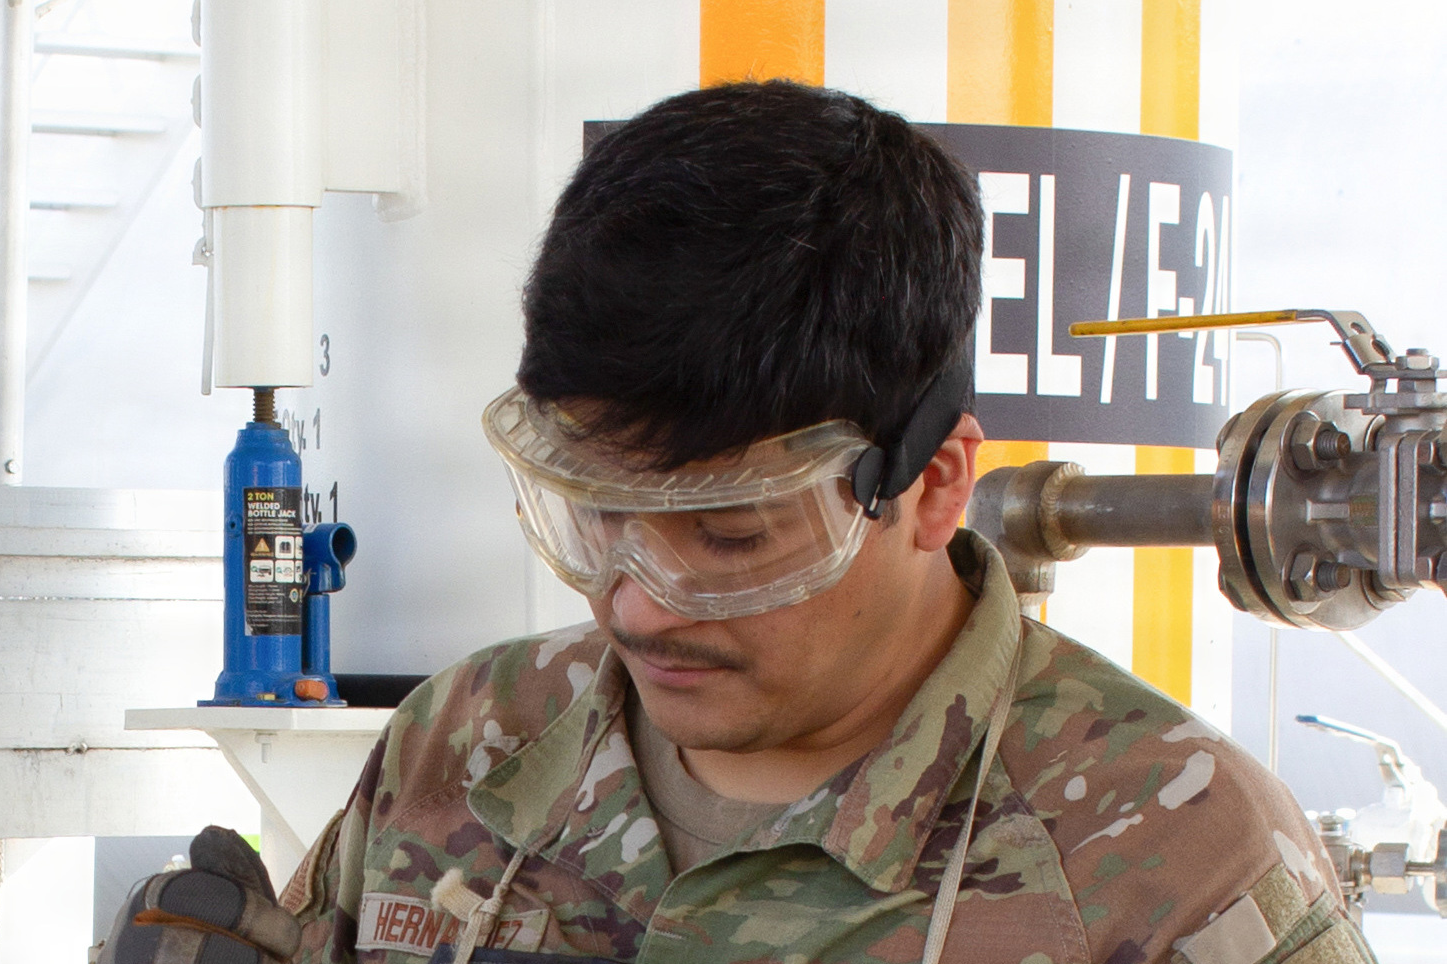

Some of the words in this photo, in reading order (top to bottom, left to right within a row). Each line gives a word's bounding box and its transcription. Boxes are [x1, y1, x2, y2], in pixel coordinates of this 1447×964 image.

[975, 171, 1082, 397] EL
[1099, 173, 1131, 404] /
[1145, 181, 1230, 406] F-24
[319, 334, 331, 377] 3
[313, 407, 321, 450] 1
[247, 492, 254, 501] 2
[255, 492, 274, 501] TON
[247, 502, 281, 510] WELDED
[247, 510, 276, 518] BOTTLE
[277, 510, 296, 518] JACK
[329, 481, 338, 523] 1
[373, 901, 525, 951] HERNAEZ
